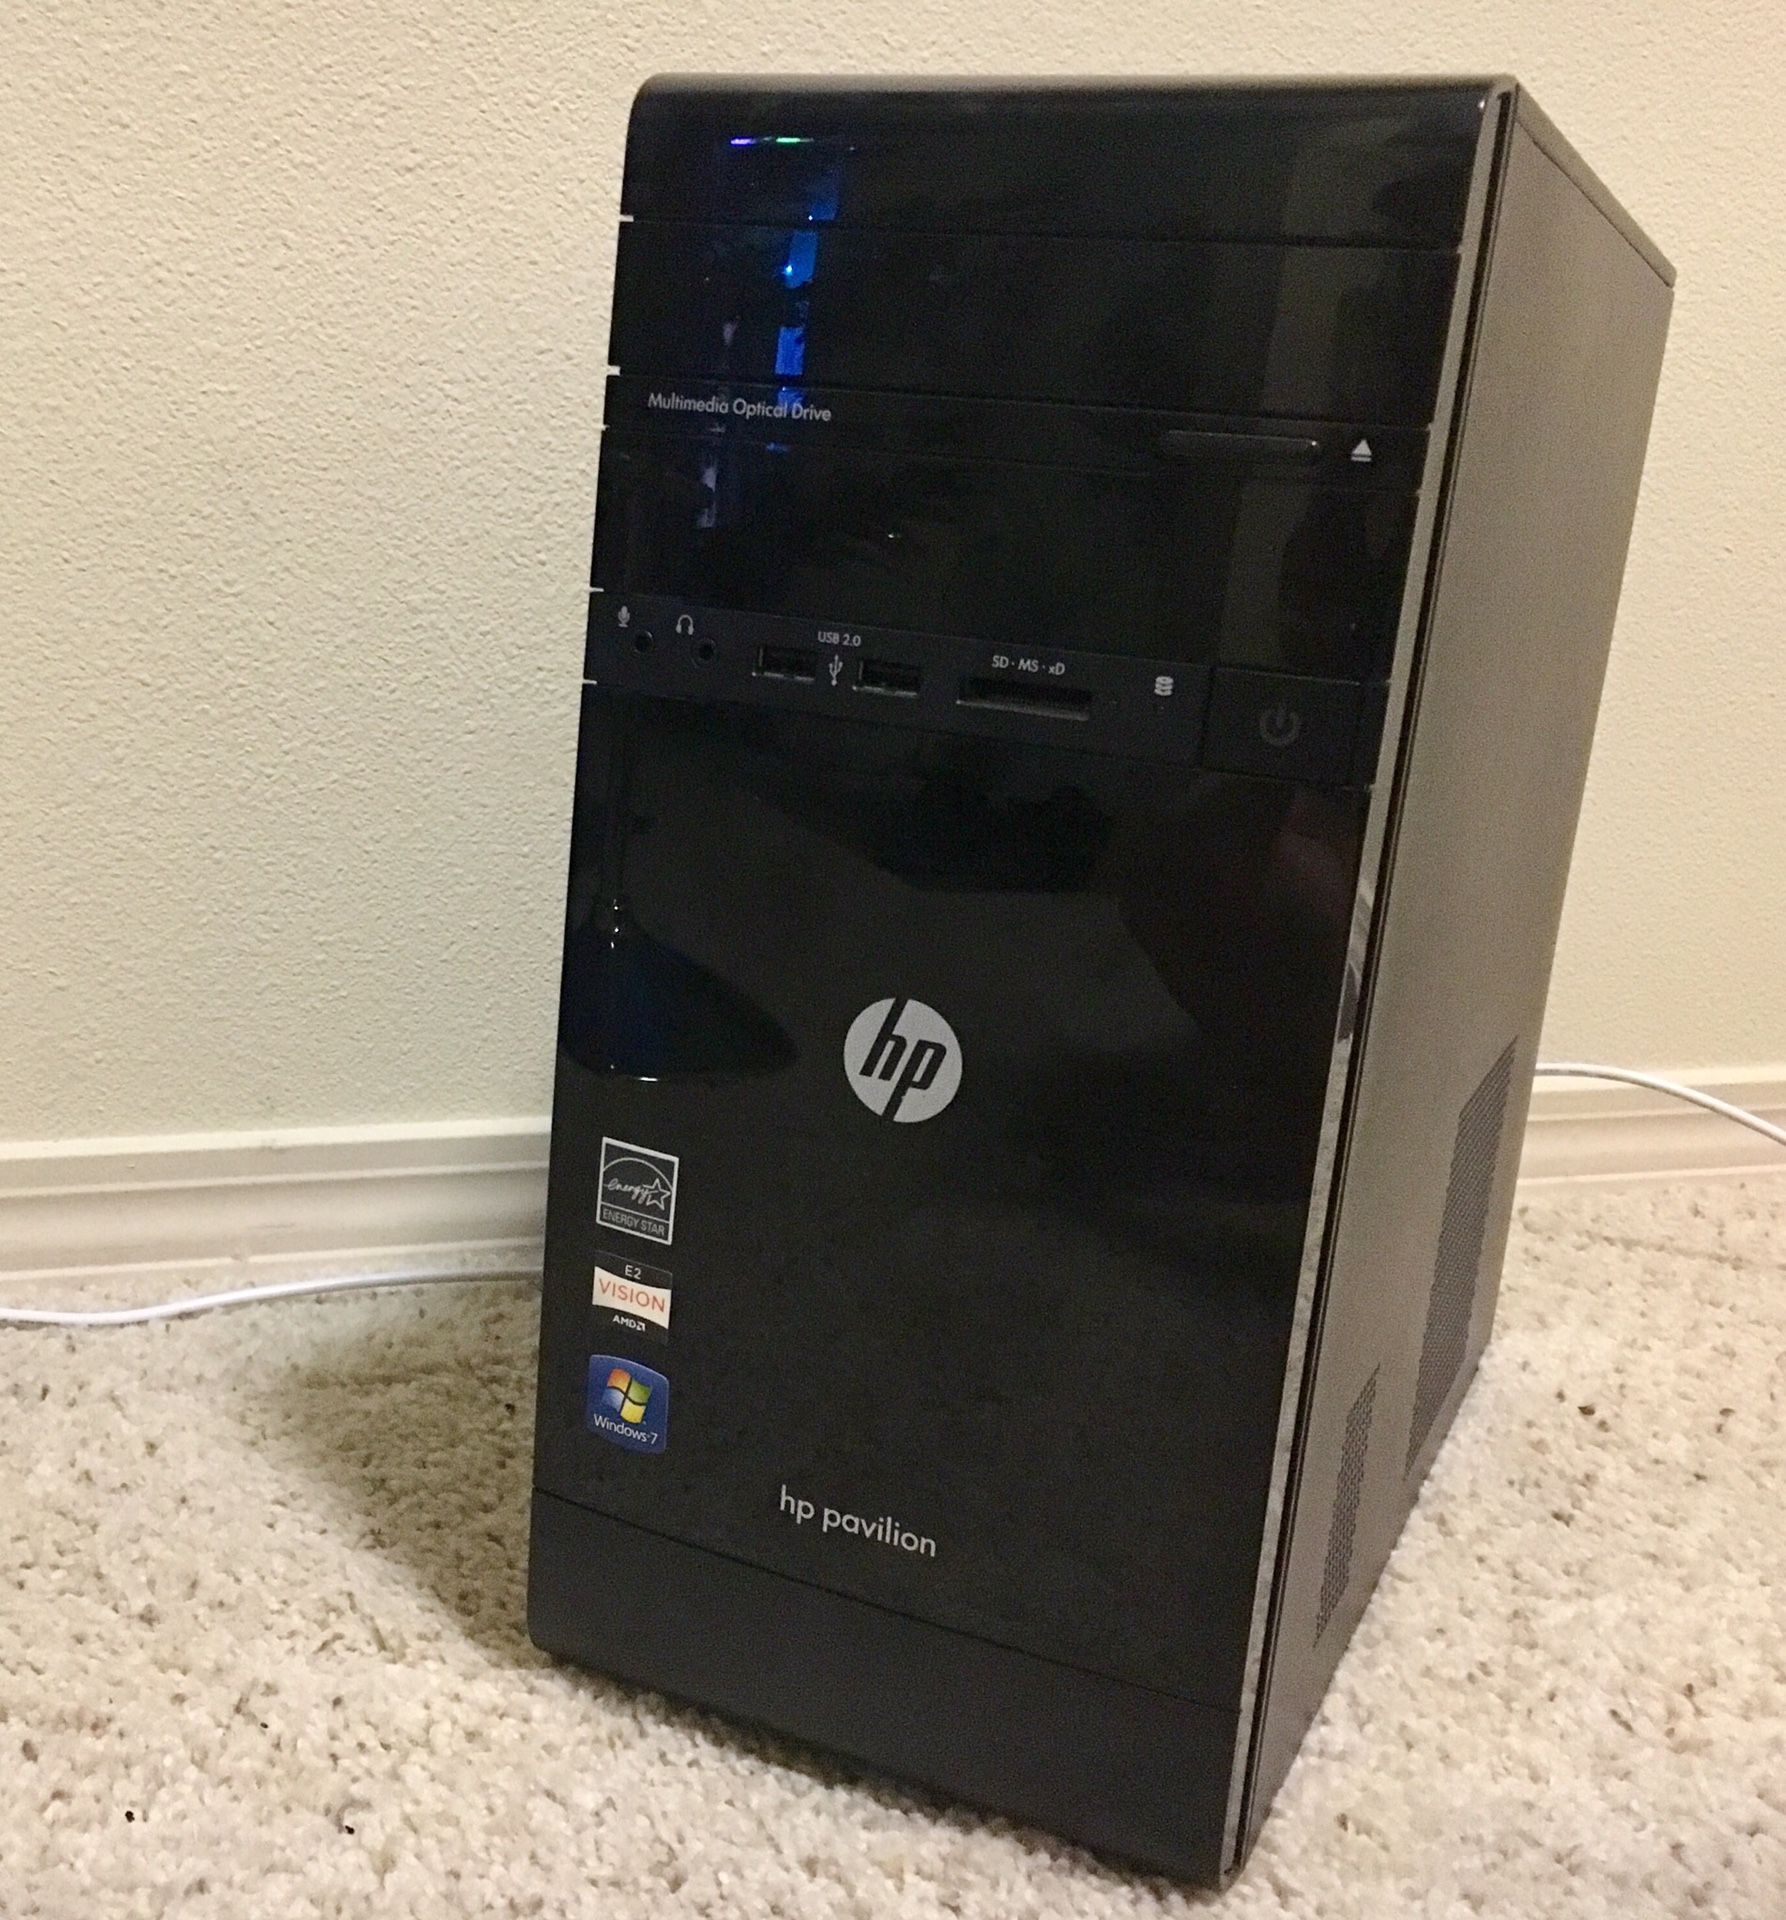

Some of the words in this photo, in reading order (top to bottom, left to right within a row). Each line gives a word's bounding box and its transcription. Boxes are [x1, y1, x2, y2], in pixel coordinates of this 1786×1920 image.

[648, 391, 728, 415] Multimedia
[733, 397, 787, 420] Optical
[791, 403, 832, 422] Drive
[817, 630, 839, 645] USB
[842, 633, 861, 647] 2.0
[992, 654, 1009, 669] SD
[1017, 658, 1039, 673] MS
[1048, 661, 1066, 676] xD
[858, 997, 947, 1121] hp
[602, 1208, 638, 1228] ENERGY
[640, 1220, 666, 1237] STAR
[624, 1264, 642, 1280] E2
[599, 1278, 666, 1313] VISION
[612, 1314, 636, 1329] AMD
[593, 1413, 647, 1442] Windows
[650, 1431, 659, 1445] 7
[780, 1484, 815, 1524] hp
[822, 1507, 936, 1557] pavilion
